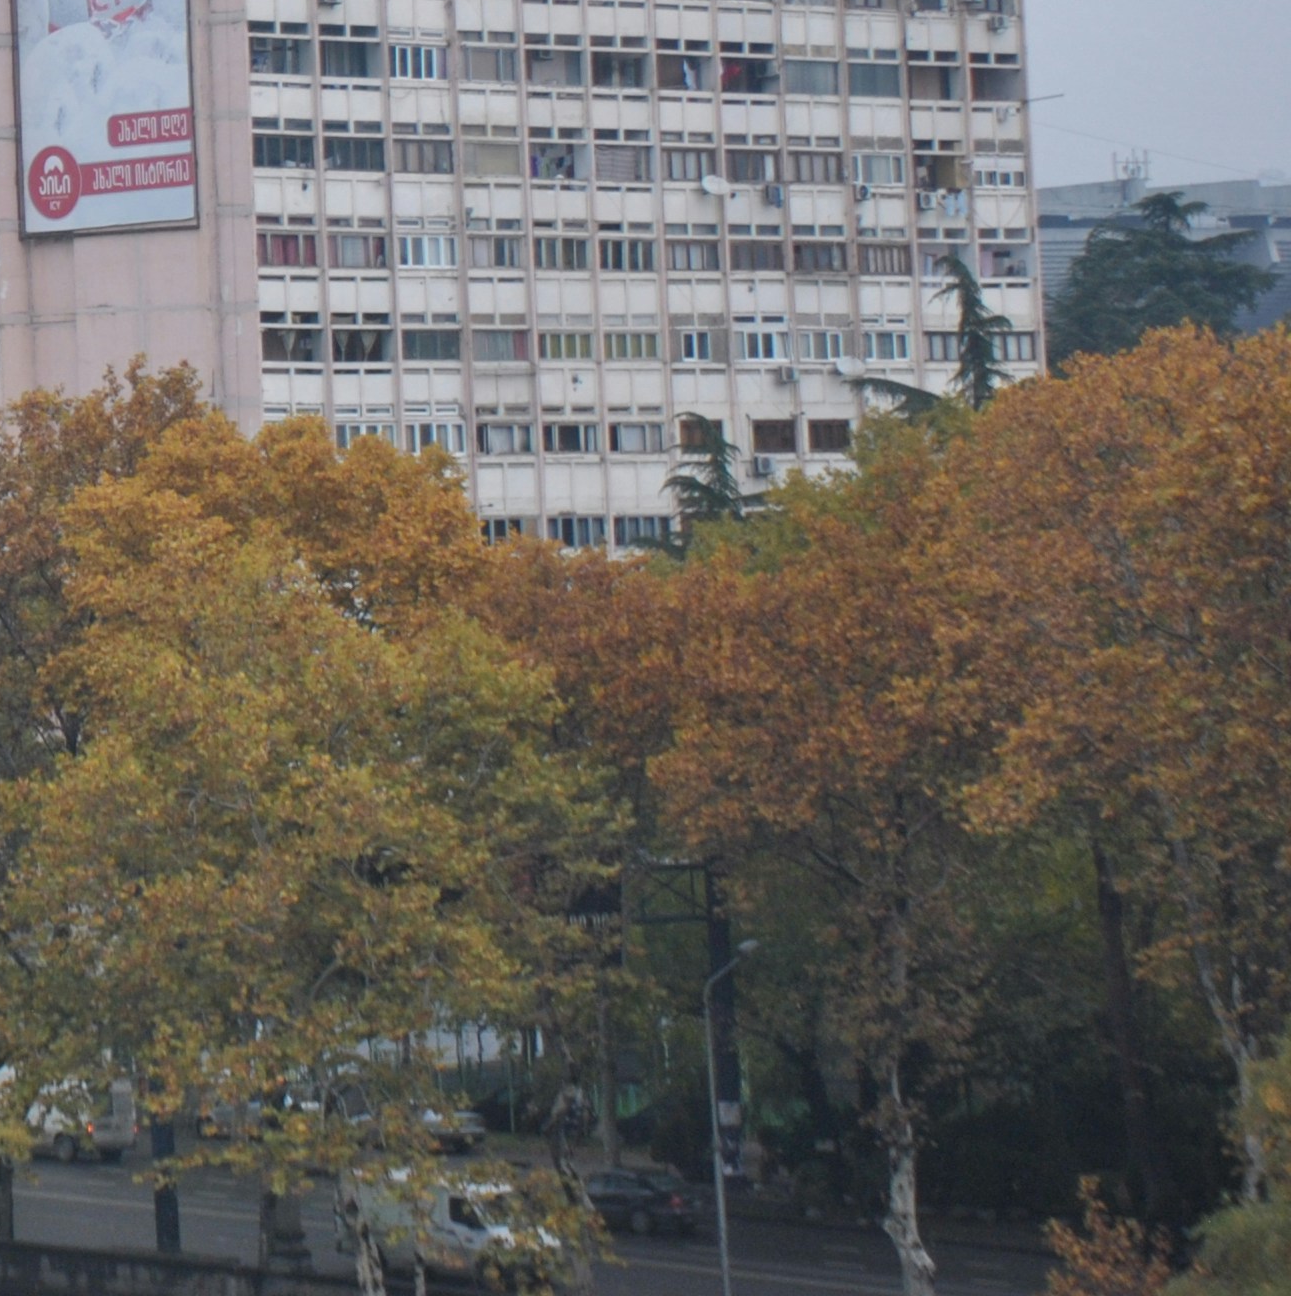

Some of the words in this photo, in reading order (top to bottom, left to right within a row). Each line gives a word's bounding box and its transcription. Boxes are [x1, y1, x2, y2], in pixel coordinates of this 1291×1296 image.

[118, 116, 158, 142] ახალი
[160, 113, 187, 138] დღე
[38, 173, 71, 196] აისი
[92, 164, 132, 191] ახალი
[134, 159, 190, 186] ისტორია
